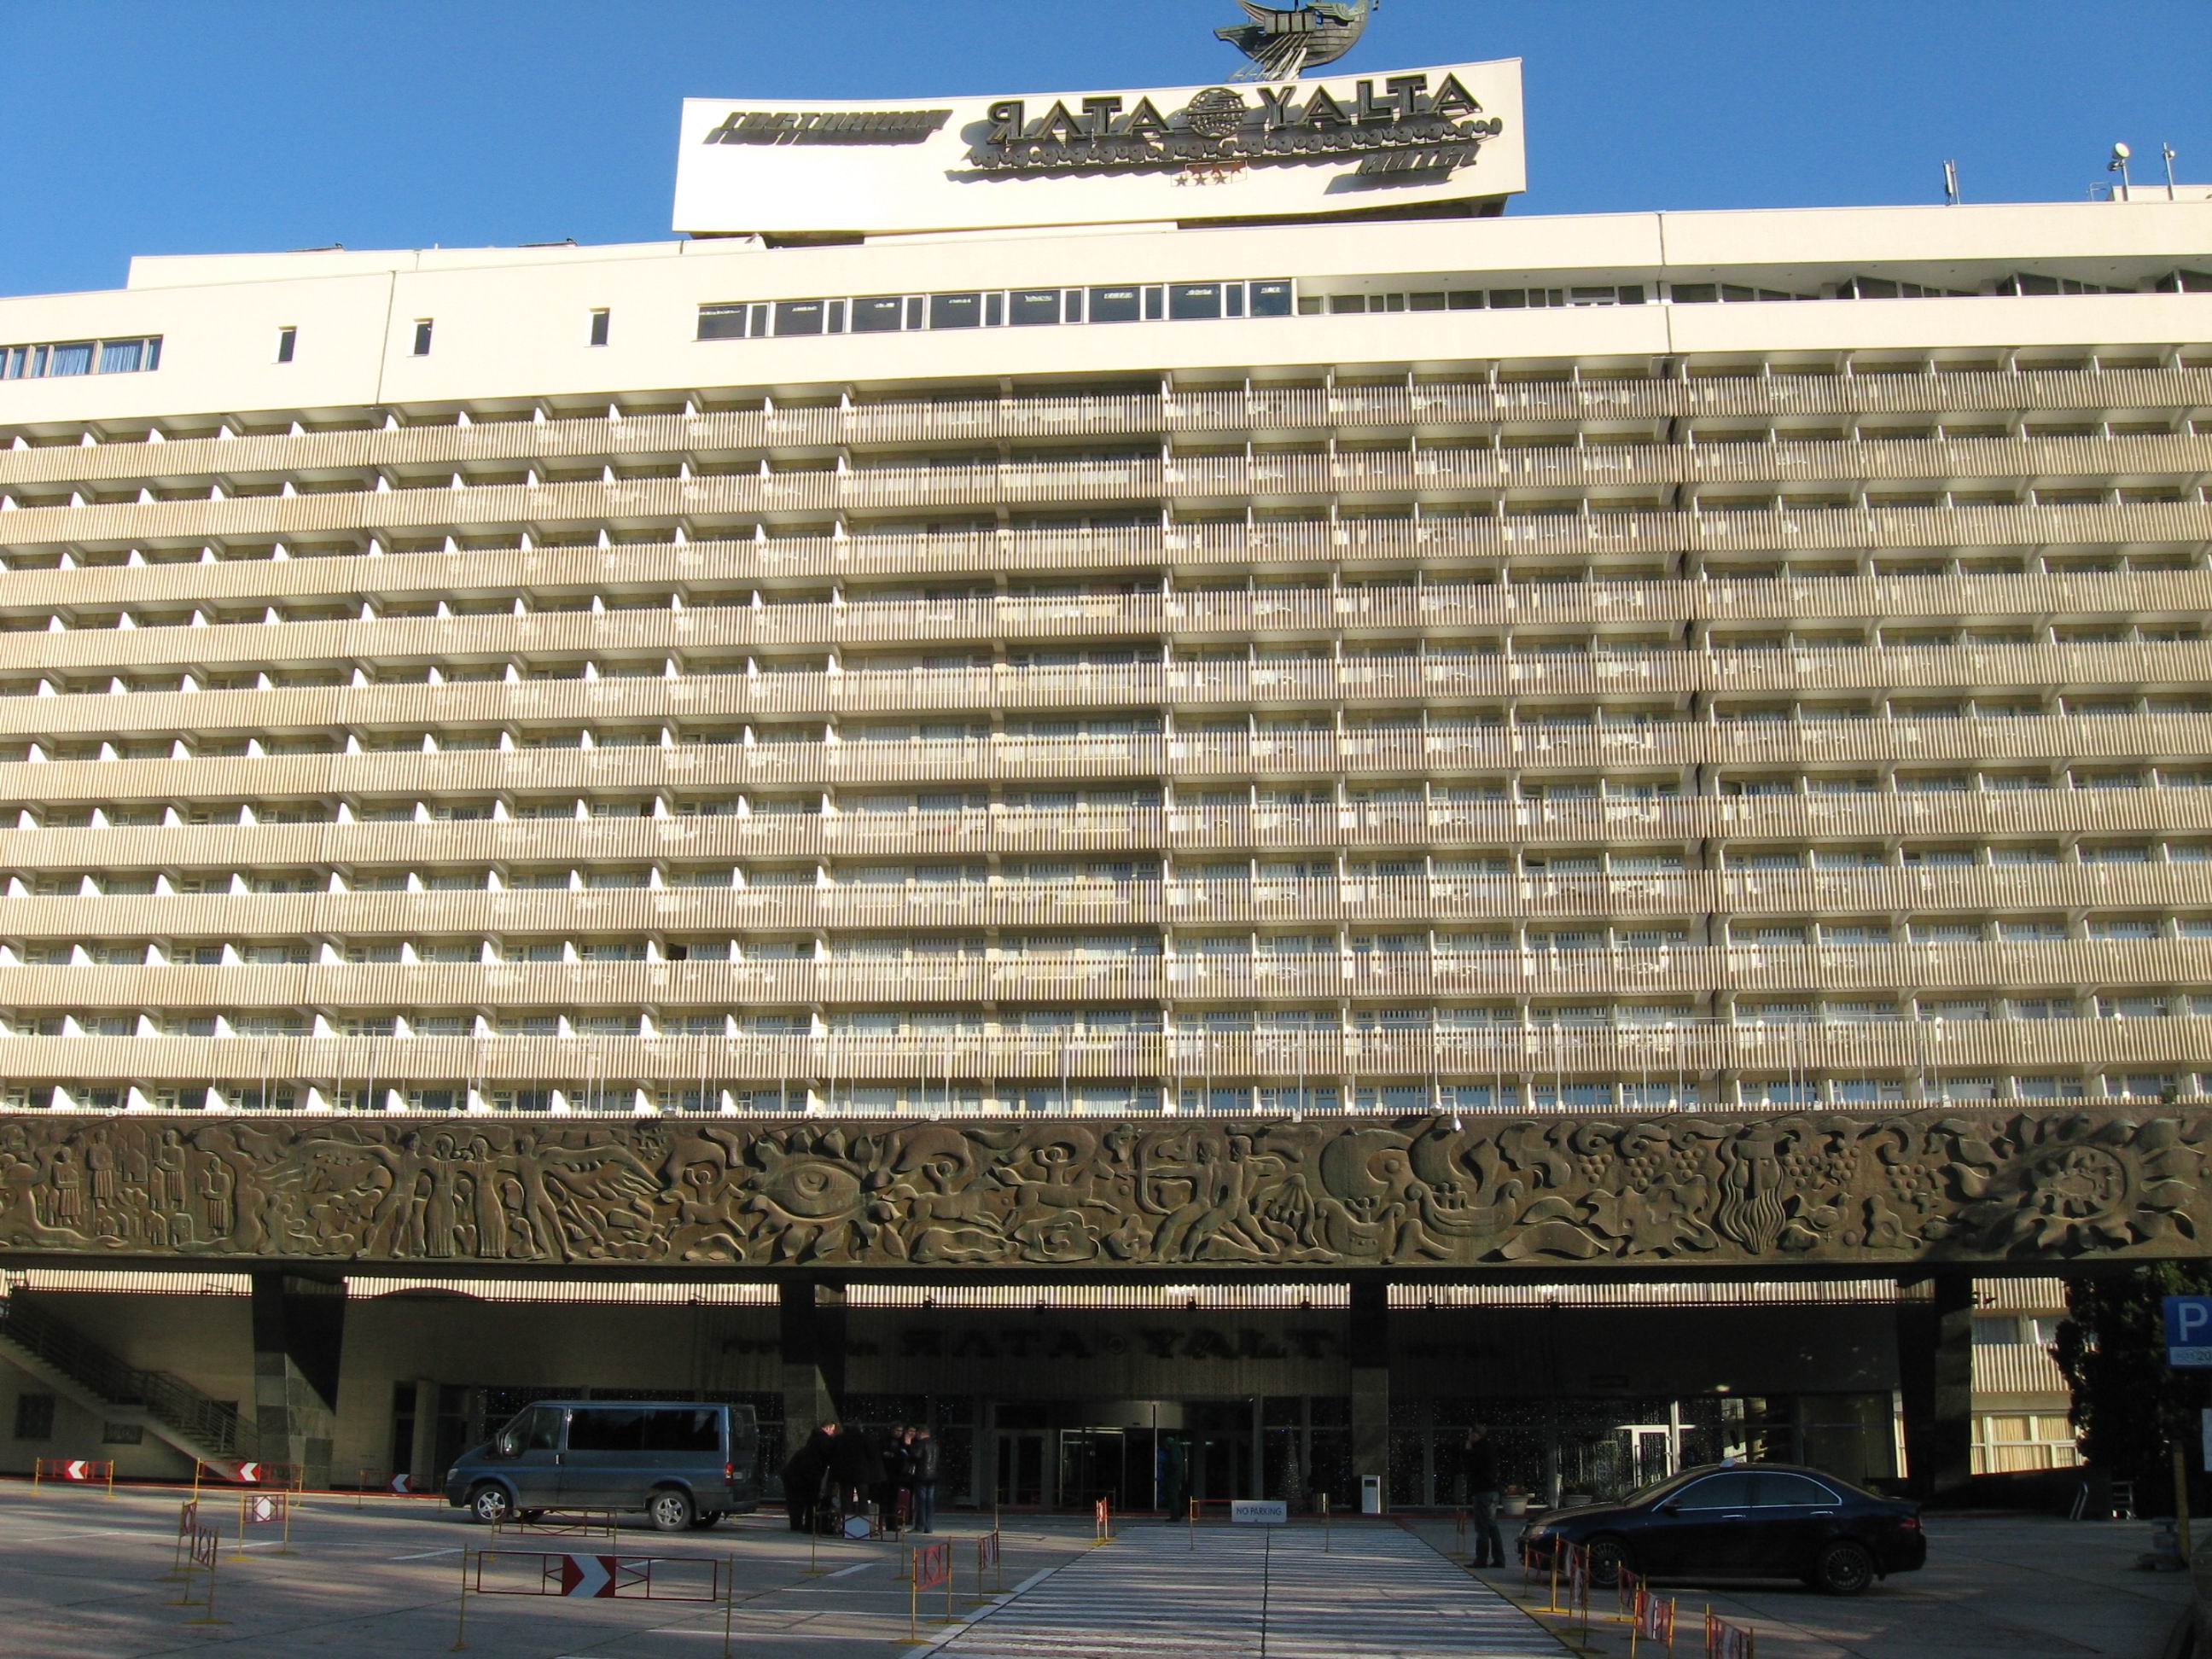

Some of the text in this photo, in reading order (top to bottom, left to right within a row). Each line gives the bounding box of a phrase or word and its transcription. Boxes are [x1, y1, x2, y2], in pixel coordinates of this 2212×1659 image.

[987, 95, 1174, 144] ЯЛТА
[1256, 72, 1482, 131] YALTA
[2178, 1301, 2209, 1342] P
[1142, 1326, 1350, 1359] YALT
[1250, 1507, 1282, 1516] PARKING
